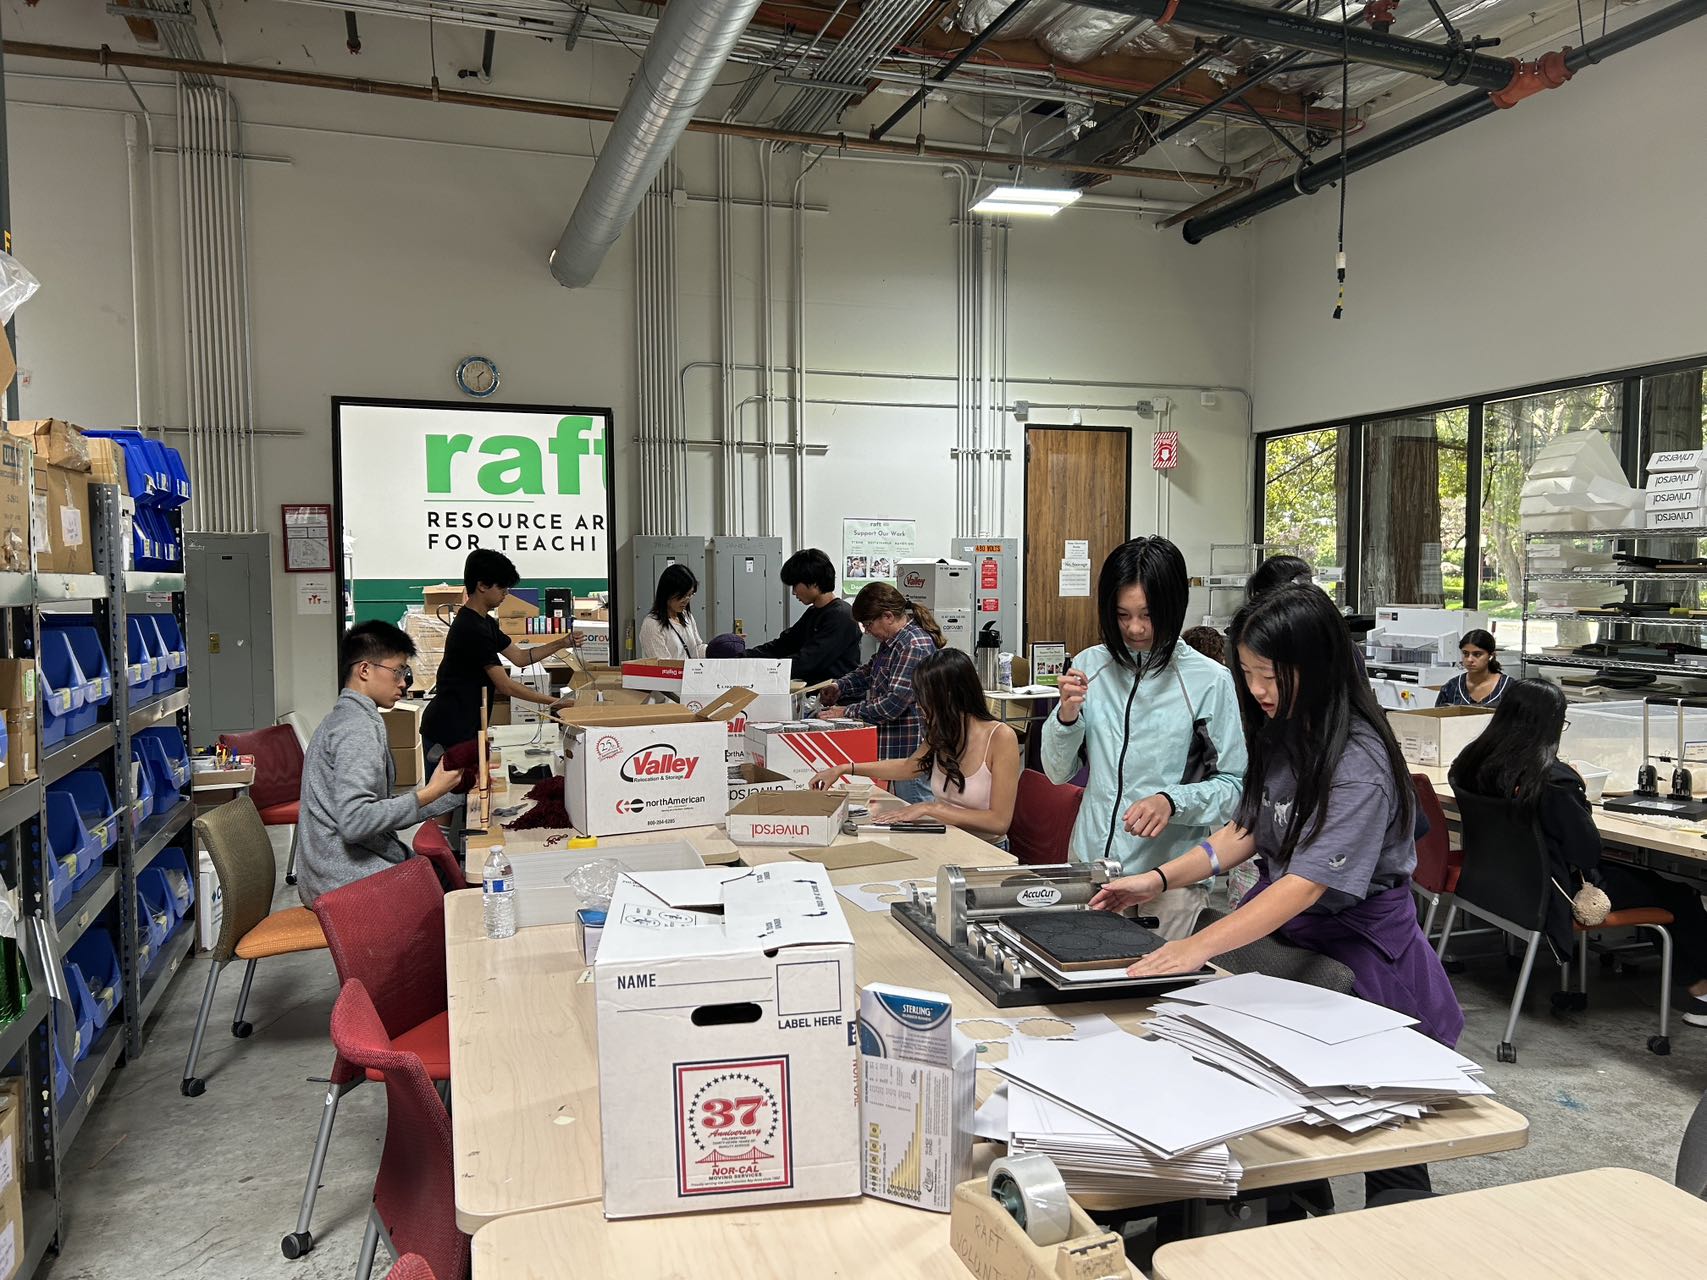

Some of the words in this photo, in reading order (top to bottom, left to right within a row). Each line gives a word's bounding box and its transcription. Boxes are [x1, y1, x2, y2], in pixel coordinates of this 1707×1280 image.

[1656, 453, 1694, 464] universal
[1655, 473, 1693, 487] universal
[1653, 492, 1691, 505] universal
[427, 511, 562, 530] RESOURCE
[575, 514, 605, 530] AR
[1656, 512, 1693, 524] universal
[428, 534, 480, 550] FOR
[498, 535, 596, 551] TEACHI
[633, 752, 699, 779] Valley
[646, 795, 705, 807] northAmerican
[752, 824, 810, 838] universal
[617, 974, 656, 989] NAME
[778, 1018, 811, 1029] LABEL
[814, 1016, 842, 1027] HERE
[708, 1128, 761, 1138] Anniversary
[712, 1165, 759, 1175] NOR-CAL
